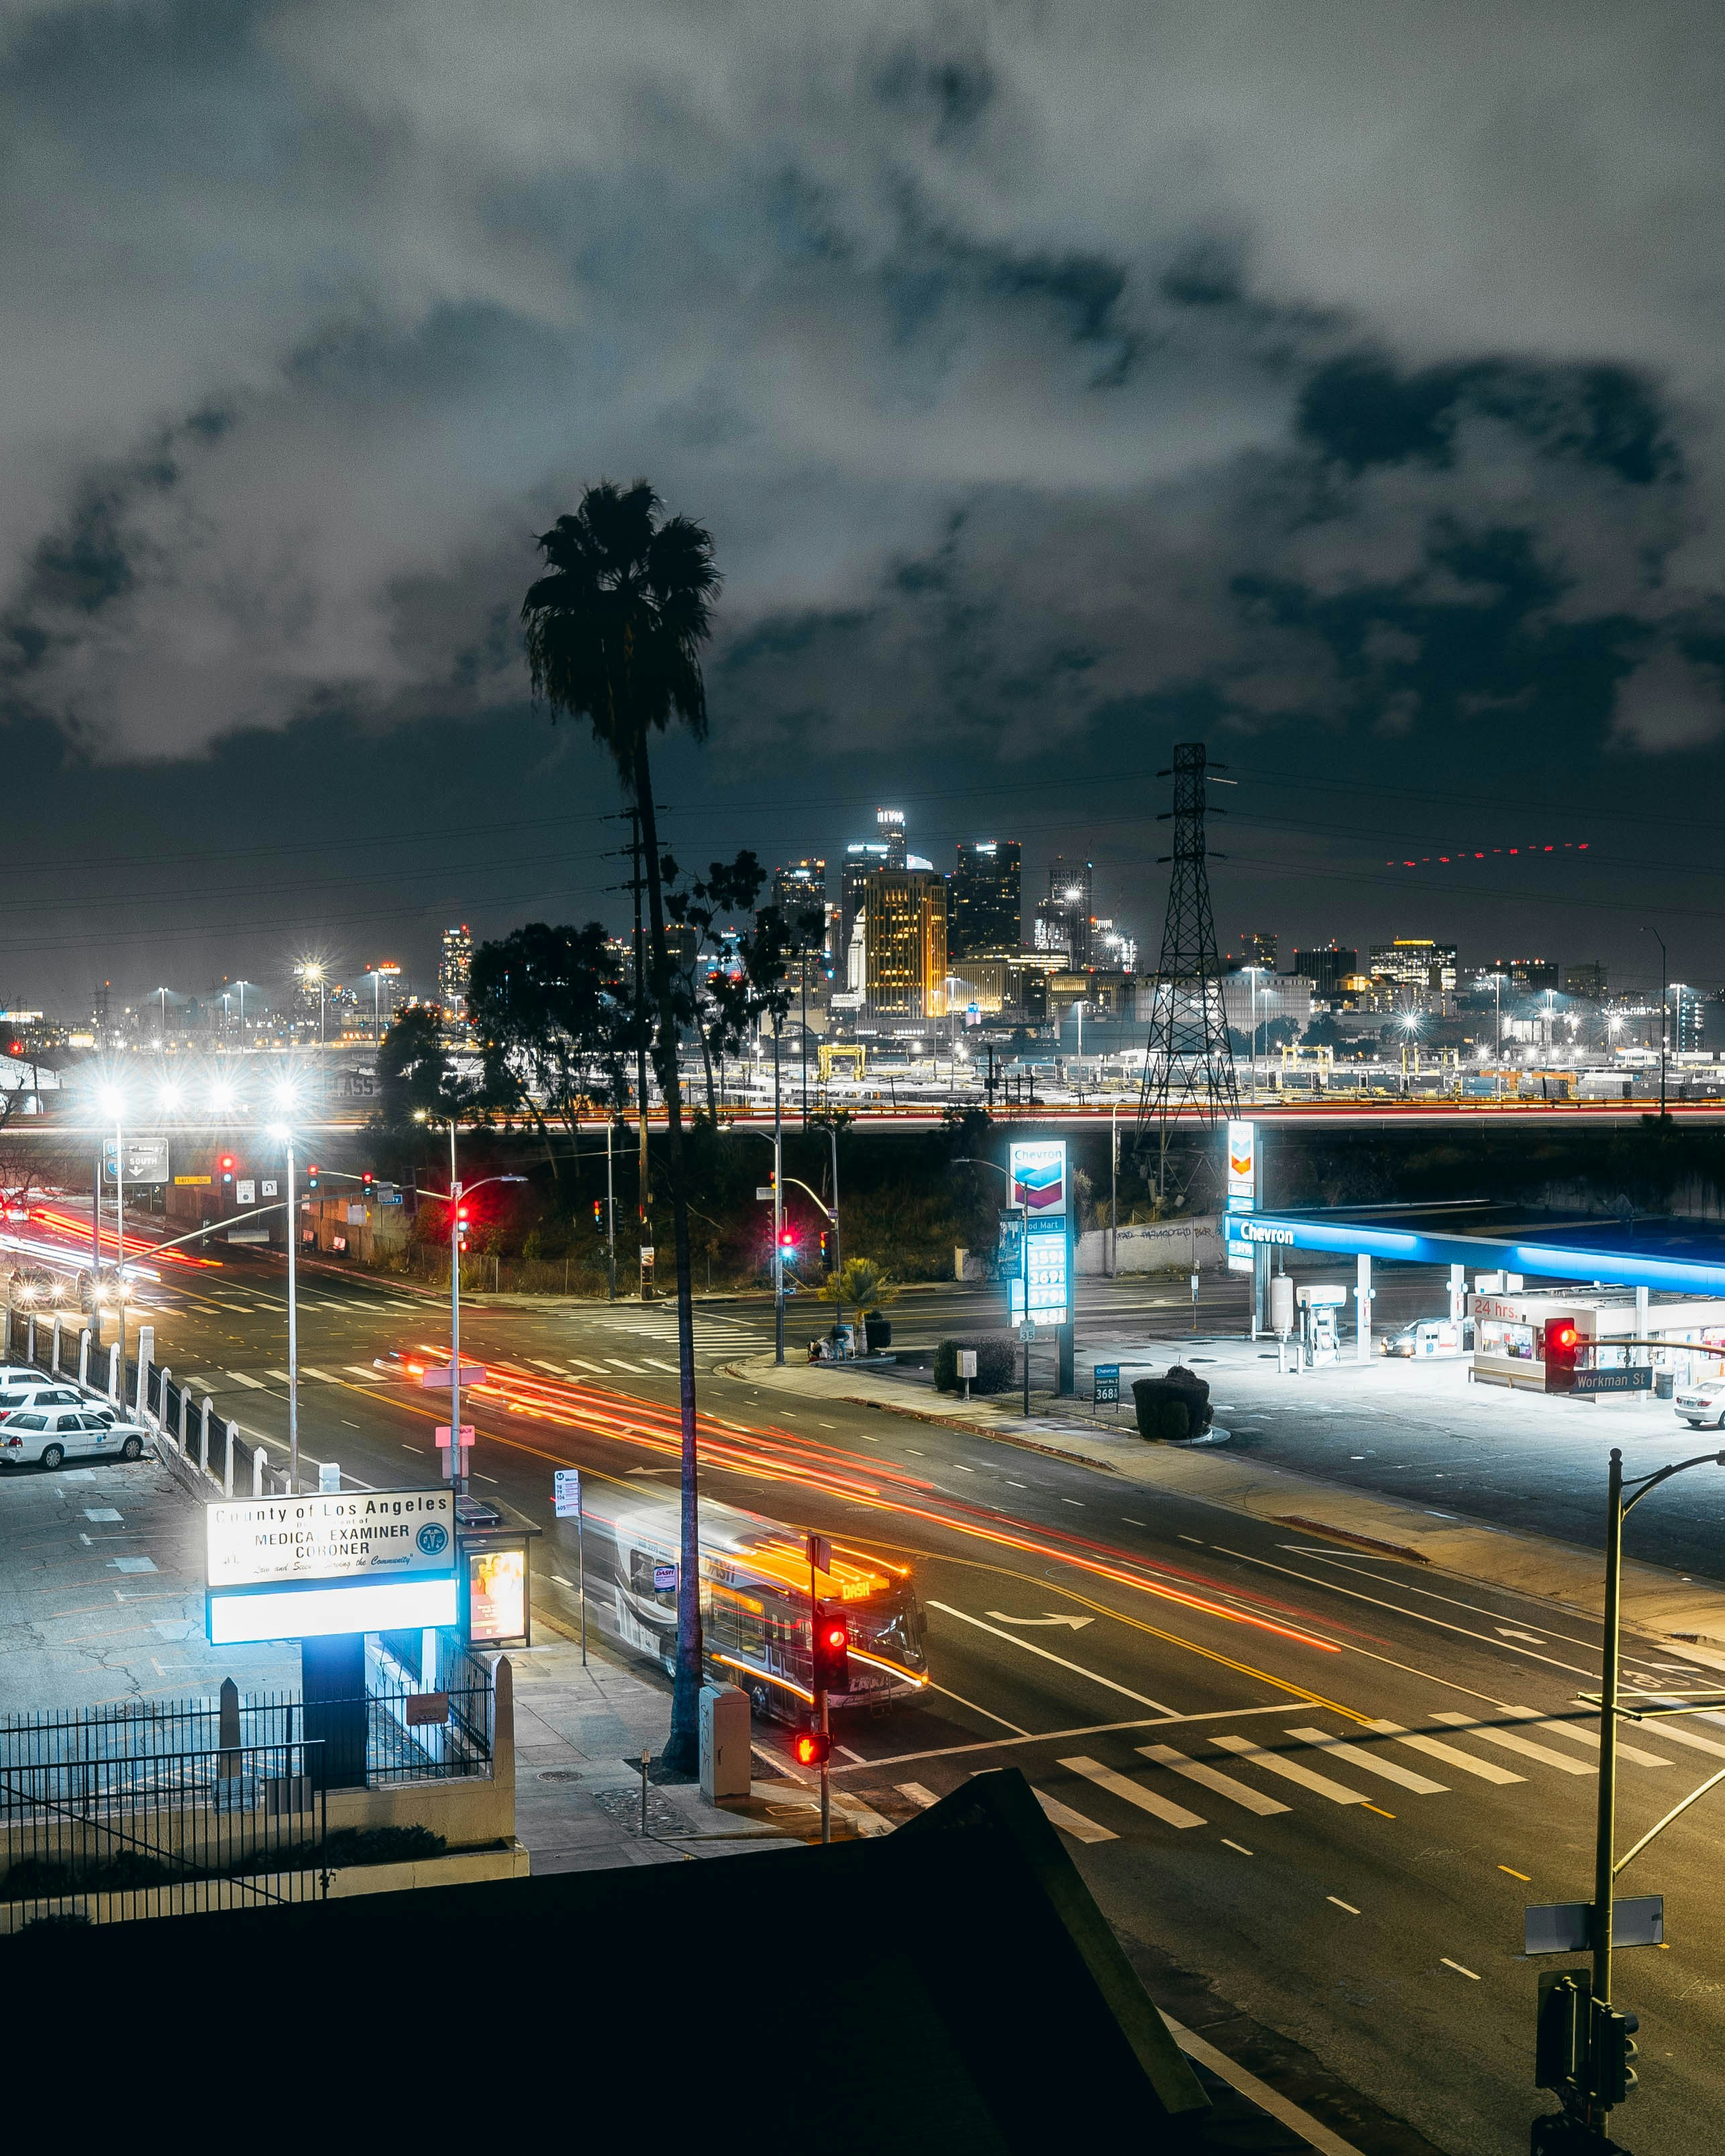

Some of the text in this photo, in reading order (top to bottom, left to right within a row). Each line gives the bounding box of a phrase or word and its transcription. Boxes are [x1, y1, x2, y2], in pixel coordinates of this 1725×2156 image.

[1014, 1149, 1062, 1161] Chevron
[1040, 1219, 1058, 1229] Mart
[1241, 1222, 1294, 1245] Chevron
[1475, 1299, 1518, 1318] 24 hrs.
[1021, 1331, 1034, 1340] 35
[1578, 1372, 1645, 1388] Workman St
[296, 1504, 313, 1518] of
[324, 1500, 357, 1516] Los
[365, 1497, 447, 1515] Angeles
[255, 1525, 409, 1546] MEDICA EXAMINER
[296, 1542, 370, 1558] CORONER
[356, 1558, 366, 1566] the
[843, 1581, 870, 1599] DASH
